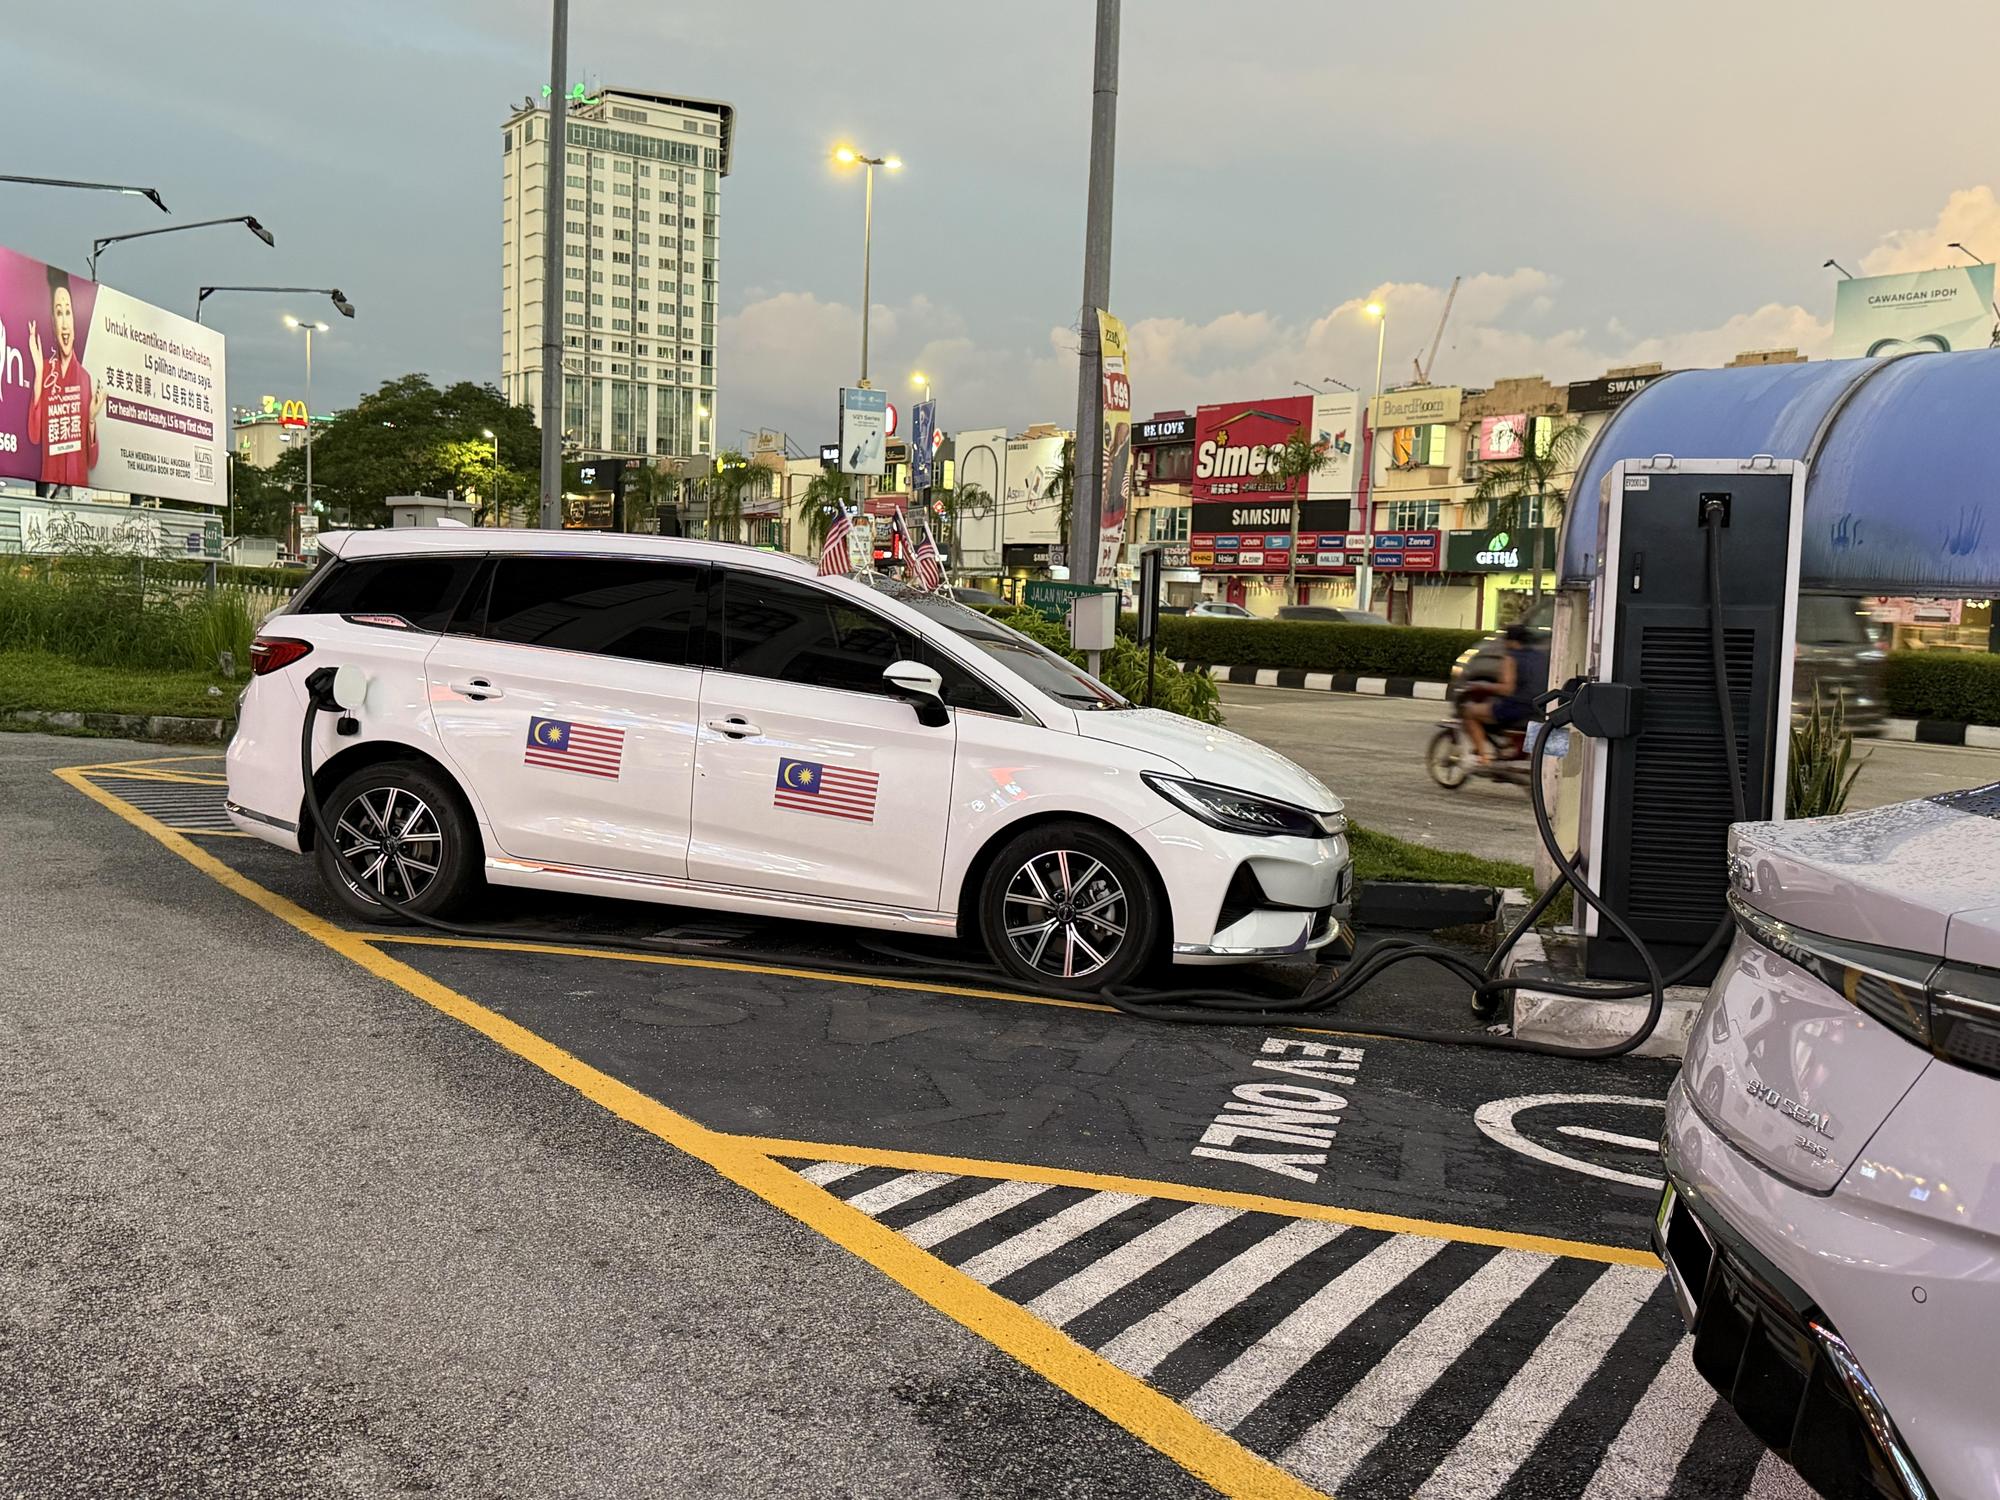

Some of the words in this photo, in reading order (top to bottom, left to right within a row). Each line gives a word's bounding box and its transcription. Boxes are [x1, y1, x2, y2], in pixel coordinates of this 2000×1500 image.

[1868, 291, 1927, 304] CAWANGAN
[1931, 288, 1957, 299] IPOH
[105, 317, 128, 338] Untuk
[130, 325, 167, 352] kecantikan
[169, 339, 180, 356] dan
[144, 354, 153, 369] LS
[154, 357, 177, 377] pilihan
[178, 367, 196, 383] utama
[1607, 380, 1646, 393] SWAN
[48, 403, 71, 417] NANCY
[71, 401, 81, 414] SIT
[1383, 398, 1443, 416] BoardRoom
[108, 400, 119, 414] For
[119, 402, 137, 417] health
[137, 409, 147, 421] and
[167, 415, 174, 427] LS
[174, 416, 179, 429] is
[180, 420, 186, 433] my
[187, 419, 197, 433] first
[1143, 425, 1156, 437] BE
[136, 461, 157, 473] MALAYSIA
[157, 465, 169, 475] BOOK
[1232, 508, 1300, 526] SAMSUN
[1296, 538, 1315, 546] HARP
[1031, 587, 1055, 602] JALAN
[1252, 1037, 1365, 1085] EV
[1747, 1079, 1781, 1109] BYD
[1780, 1098, 1834, 1140] SEAL
[1190, 1083, 1349, 1184] ONLY
